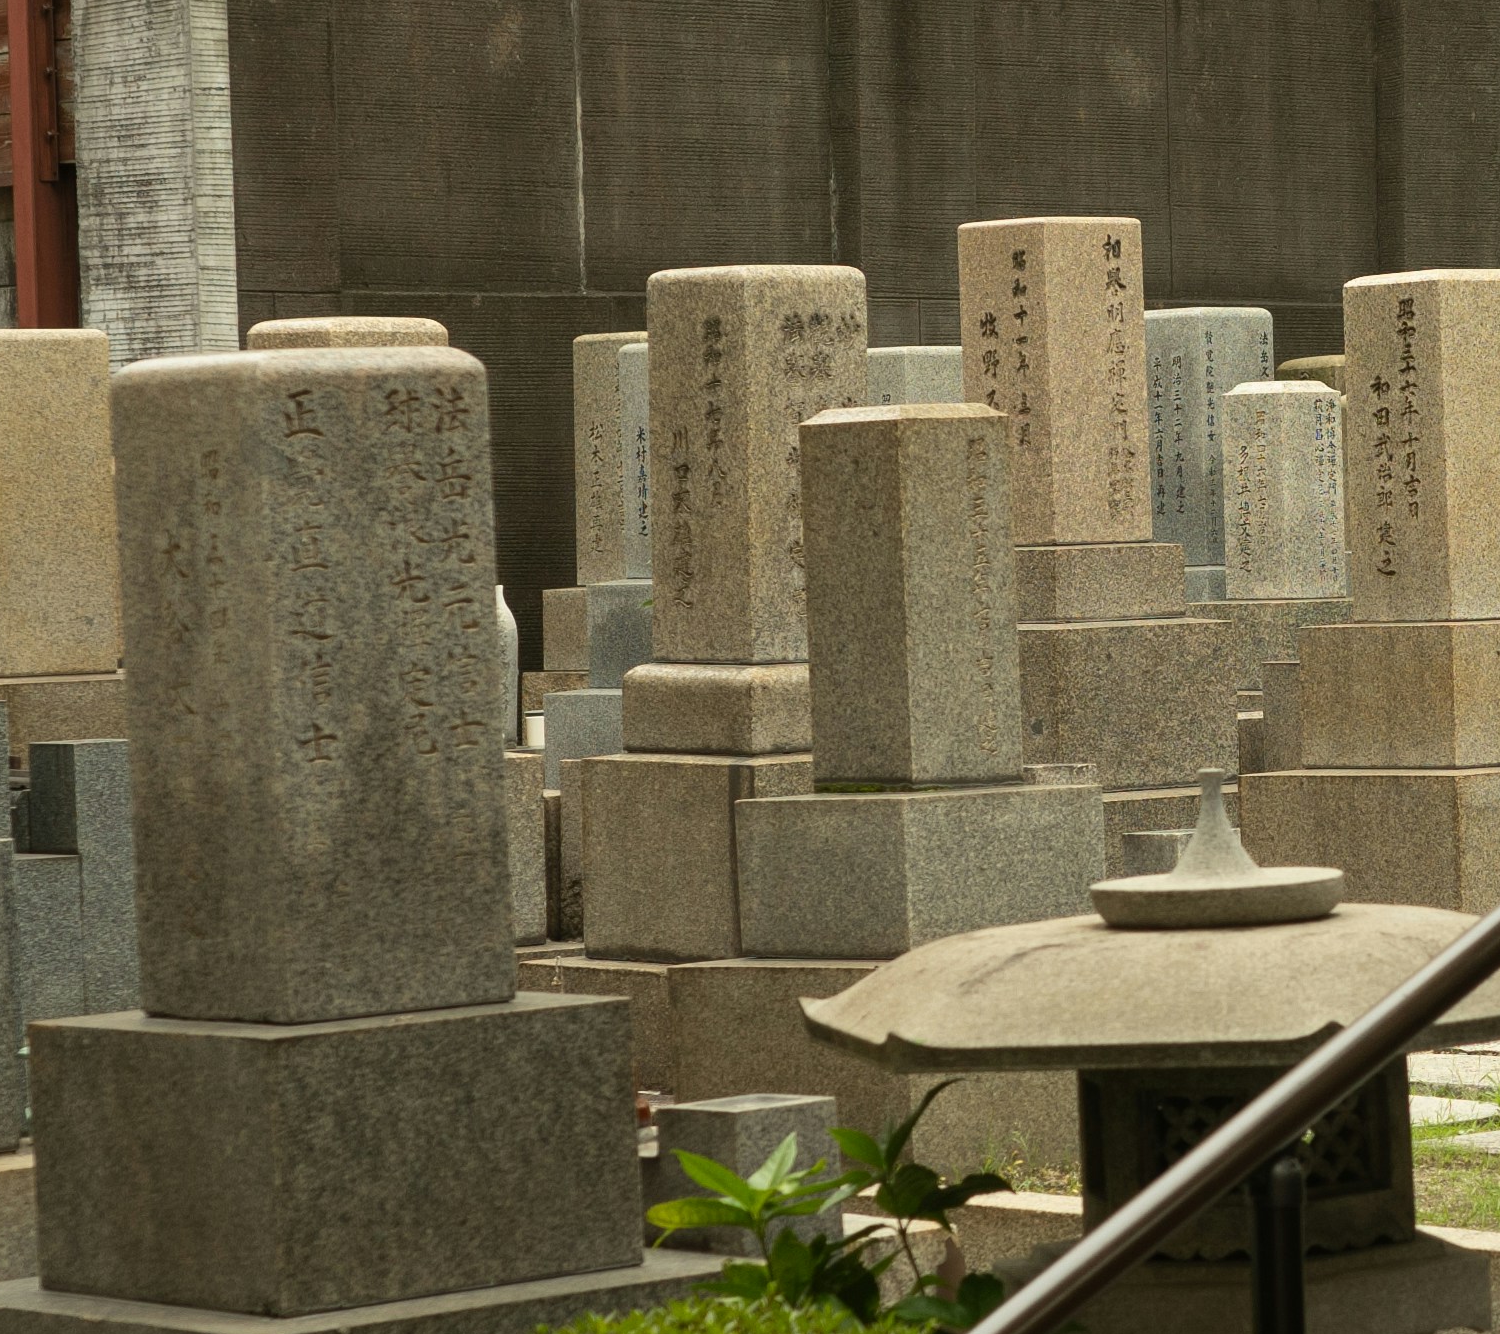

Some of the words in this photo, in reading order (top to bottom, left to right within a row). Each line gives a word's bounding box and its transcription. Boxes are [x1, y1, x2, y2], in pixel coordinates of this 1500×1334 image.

[1169, 355, 1187, 514] 明治三十二年九月建之
